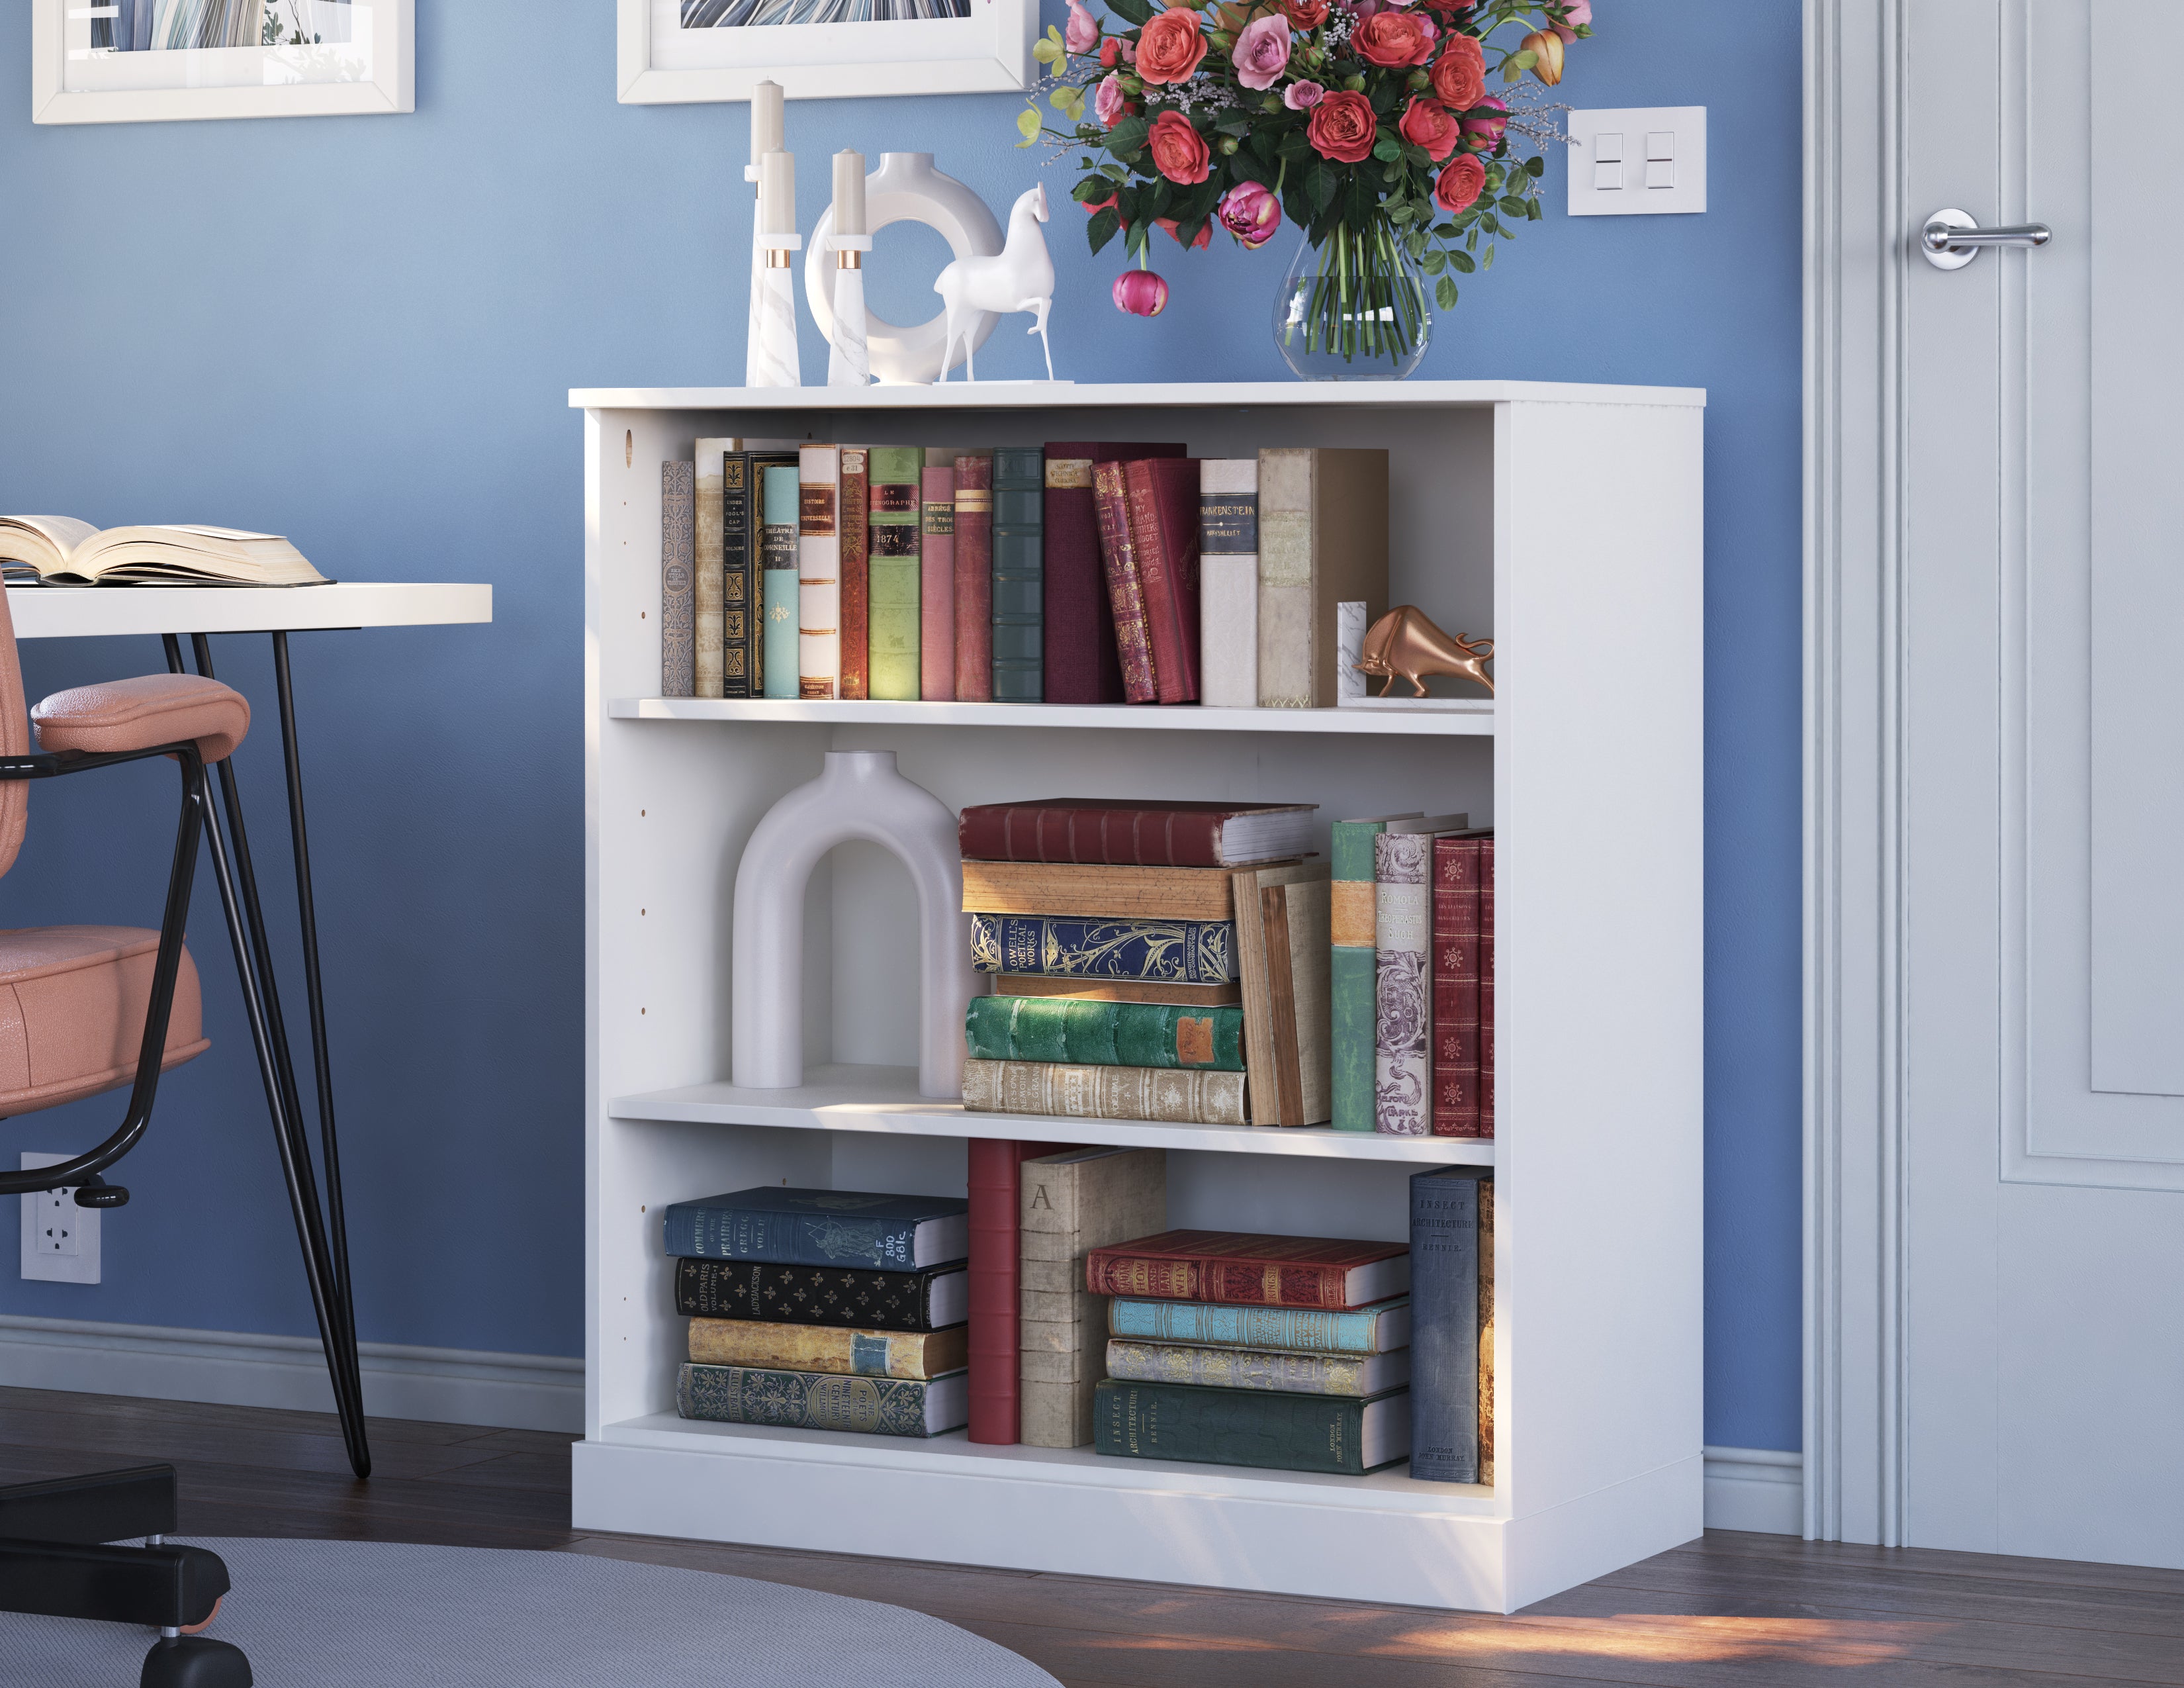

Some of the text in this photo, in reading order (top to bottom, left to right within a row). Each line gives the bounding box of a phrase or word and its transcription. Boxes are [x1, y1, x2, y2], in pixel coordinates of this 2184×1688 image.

[1135, 504, 1145, 514] MY
[1200, 506, 1255, 516] FRANKENSTEIN
[1381, 892, 1419, 905] ROMOLA
[1378, 910, 1422, 924] THEOPHRASTUS
[1009, 919, 1019, 972] LOWELL'S
[1017, 925, 1027, 968] POETICAL
[1388, 927, 1414, 940] SUCH
[1026, 931, 1037, 966] WORKS
[1029, 1184, 1055, 1210] A
[1420, 1199, 1464, 1210] INSECT
[695, 1207, 705, 1254] COMMERC
[876, 1239, 884, 1248] F
[700, 1264, 709, 1311] OLD PARIS
[751, 1266, 762, 1315] LADY JACKSON
[1119, 1260, 1130, 1292] MADAM
[1136, 1262, 1146, 1291] HOW
[1160, 1264, 1170, 1291] LADY
[1175, 1265, 1185, 1294] WHY
[730, 1370, 741, 1421] ILLUSTRATED
[831, 1383, 841, 1421] CENTURY
[841, 1380, 852, 1429] NINETEENTH
[859, 1389, 868, 1422] POETS
[1113, 1395, 1121, 1443] INSECT
[1418, 1452, 1433, 1460] JOHN
[1427, 1446, 1453, 1454] LONDON
